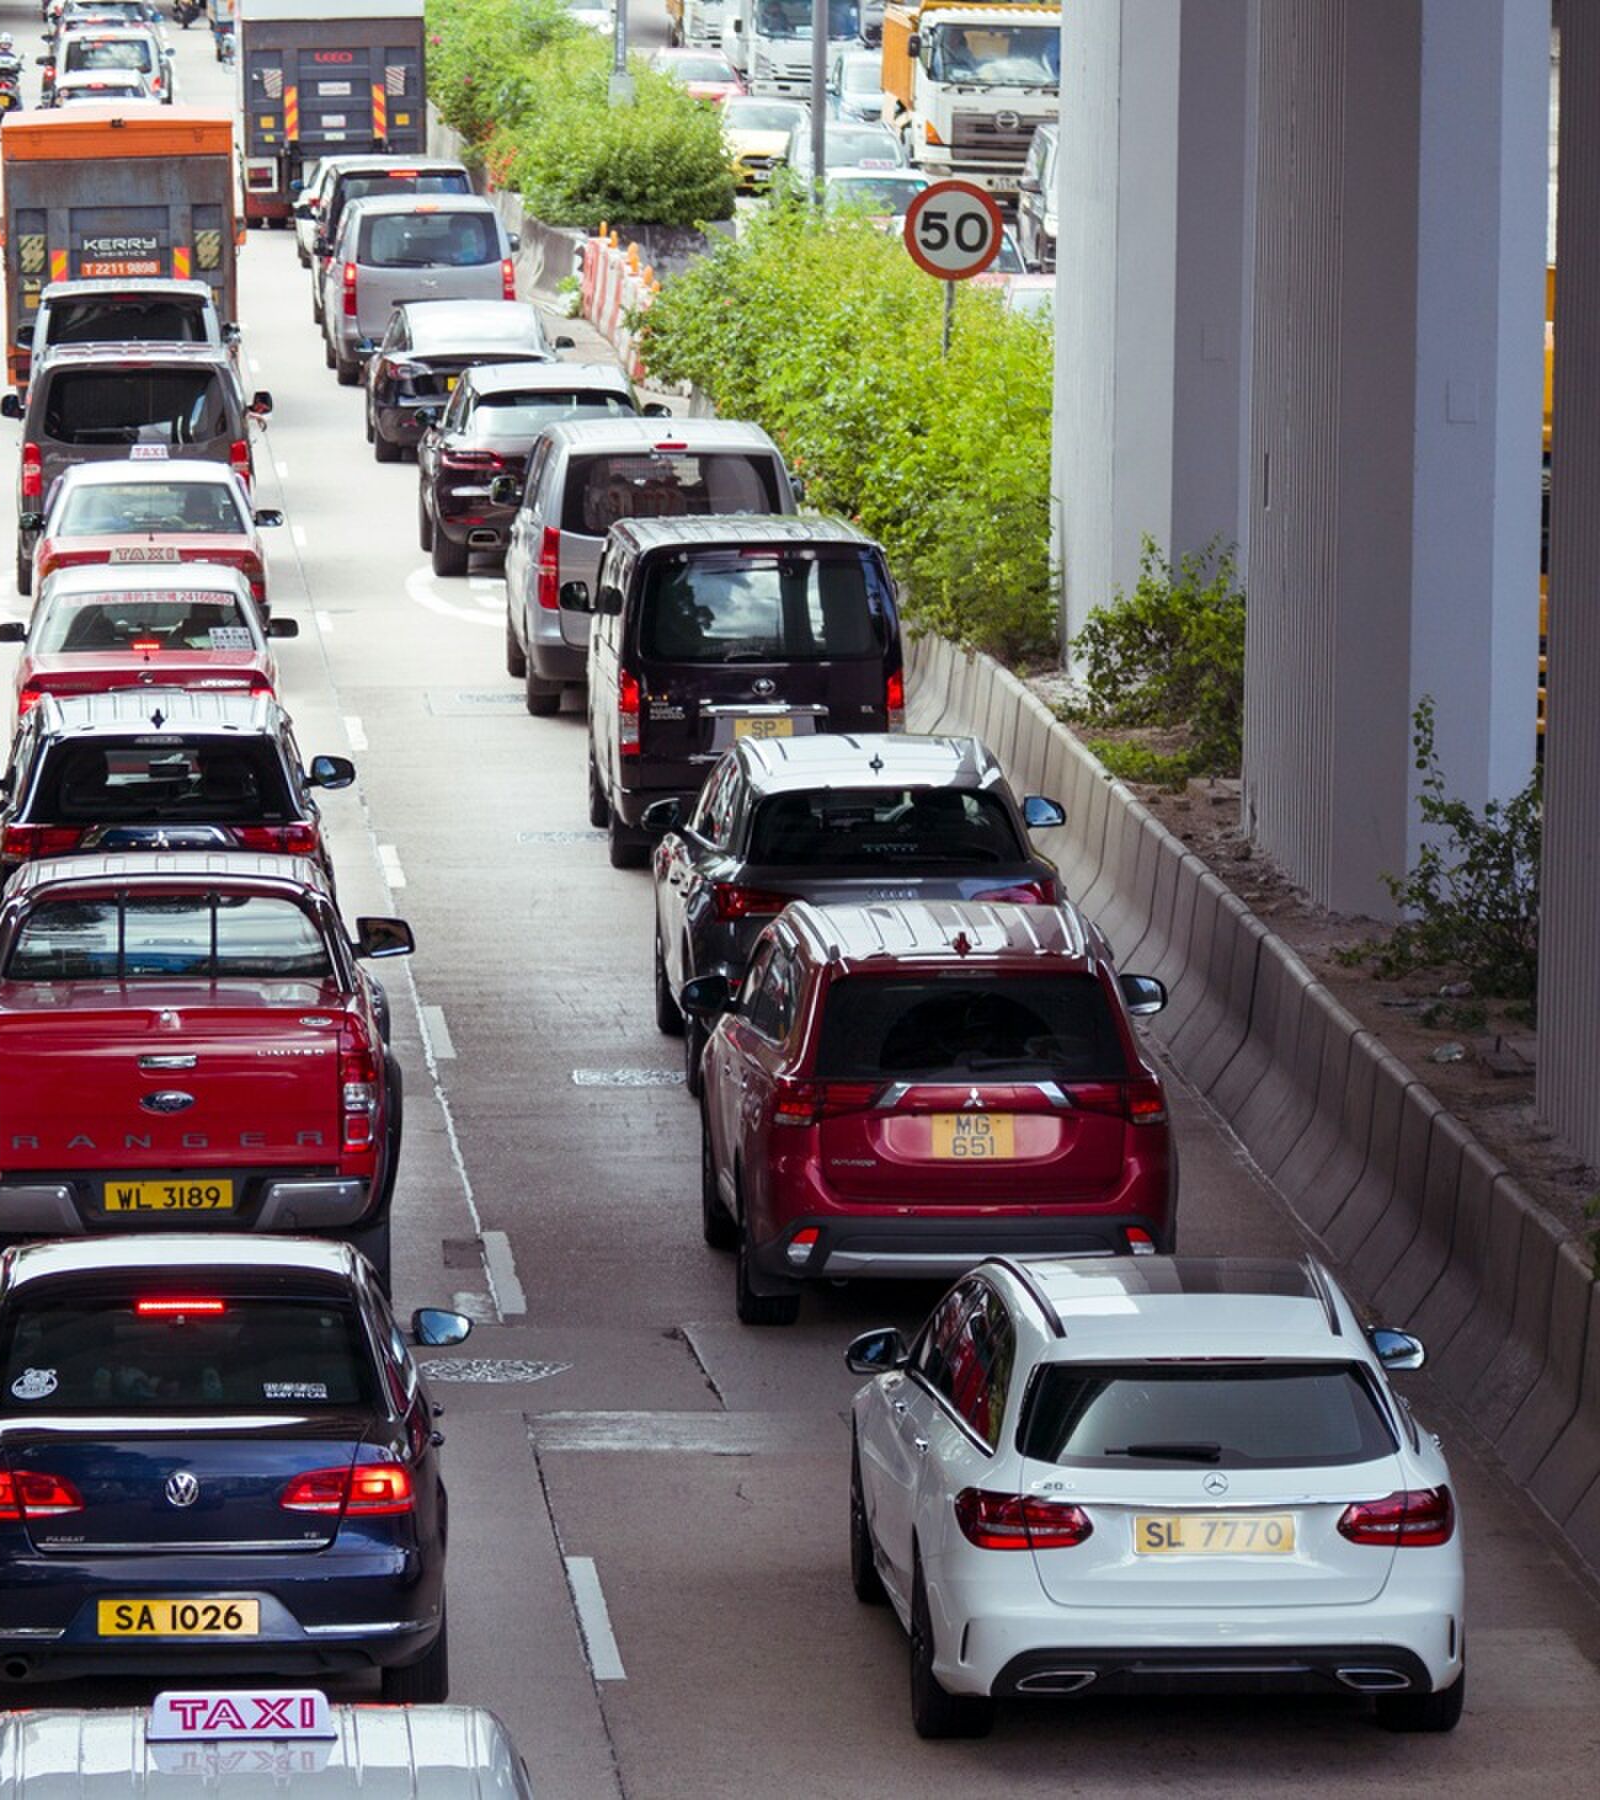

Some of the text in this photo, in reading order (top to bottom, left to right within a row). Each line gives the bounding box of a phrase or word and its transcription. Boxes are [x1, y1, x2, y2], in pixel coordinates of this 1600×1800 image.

[920, 211, 989, 253] 50
[83, 238, 157, 251] KERRY
[136, 448, 166, 457] TAXI
[117, 549, 175, 561] TAXI
[750, 721, 777, 737] SP
[956, 1116, 990, 1135] MG
[12, 1131, 324, 1149] RANGER
[952, 1137, 995, 1156] 651
[117, 1187, 221, 1209] WL 3189
[1147, 1522, 1282, 1547] SL 7770
[115, 1605, 243, 1630] SA 1026
[169, 1698, 315, 1731] TAXI
